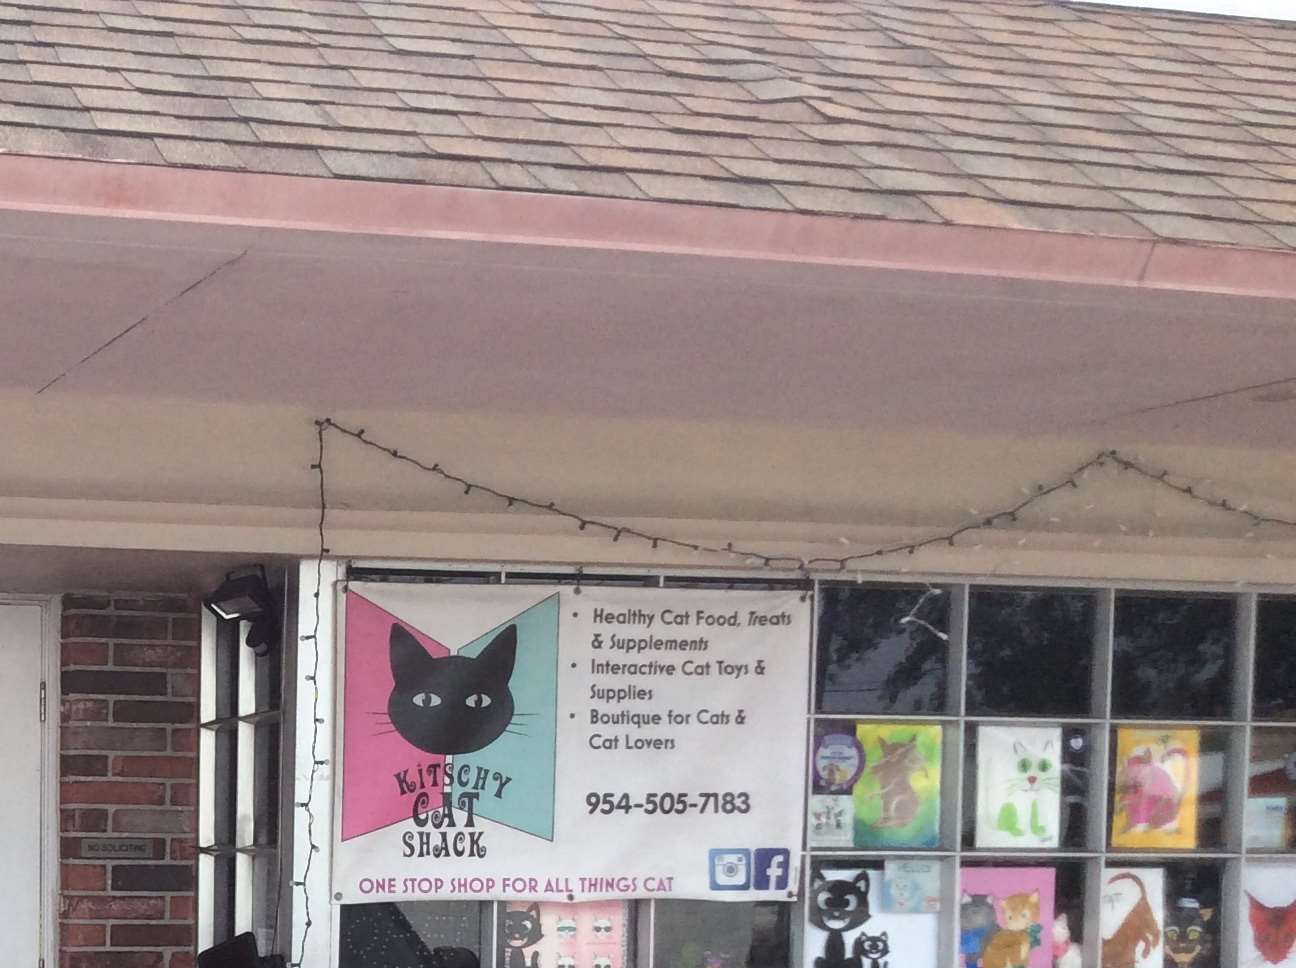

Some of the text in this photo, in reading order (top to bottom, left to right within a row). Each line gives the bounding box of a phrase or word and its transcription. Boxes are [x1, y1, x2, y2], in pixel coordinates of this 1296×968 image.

[593, 608, 655, 628] Healthy
[660, 610, 690, 626] Cat
[747, 611, 792, 626] Treats
[591, 634, 709, 653] & Supplements
[591, 658, 765, 679] Interactive Cat Toys &
[590, 684, 653, 703] Supplies
[590, 709, 746, 728] Boutique for Cats &
[589, 734, 676, 750] Cat Lovers
[412, 792, 480, 829] CAT
[585, 792, 750, 815] 954-505-7183
[402, 831, 486, 858] SHACK
[359, 877, 674, 894] ONE STOP SHOP FOR ALL THINGS CAT
